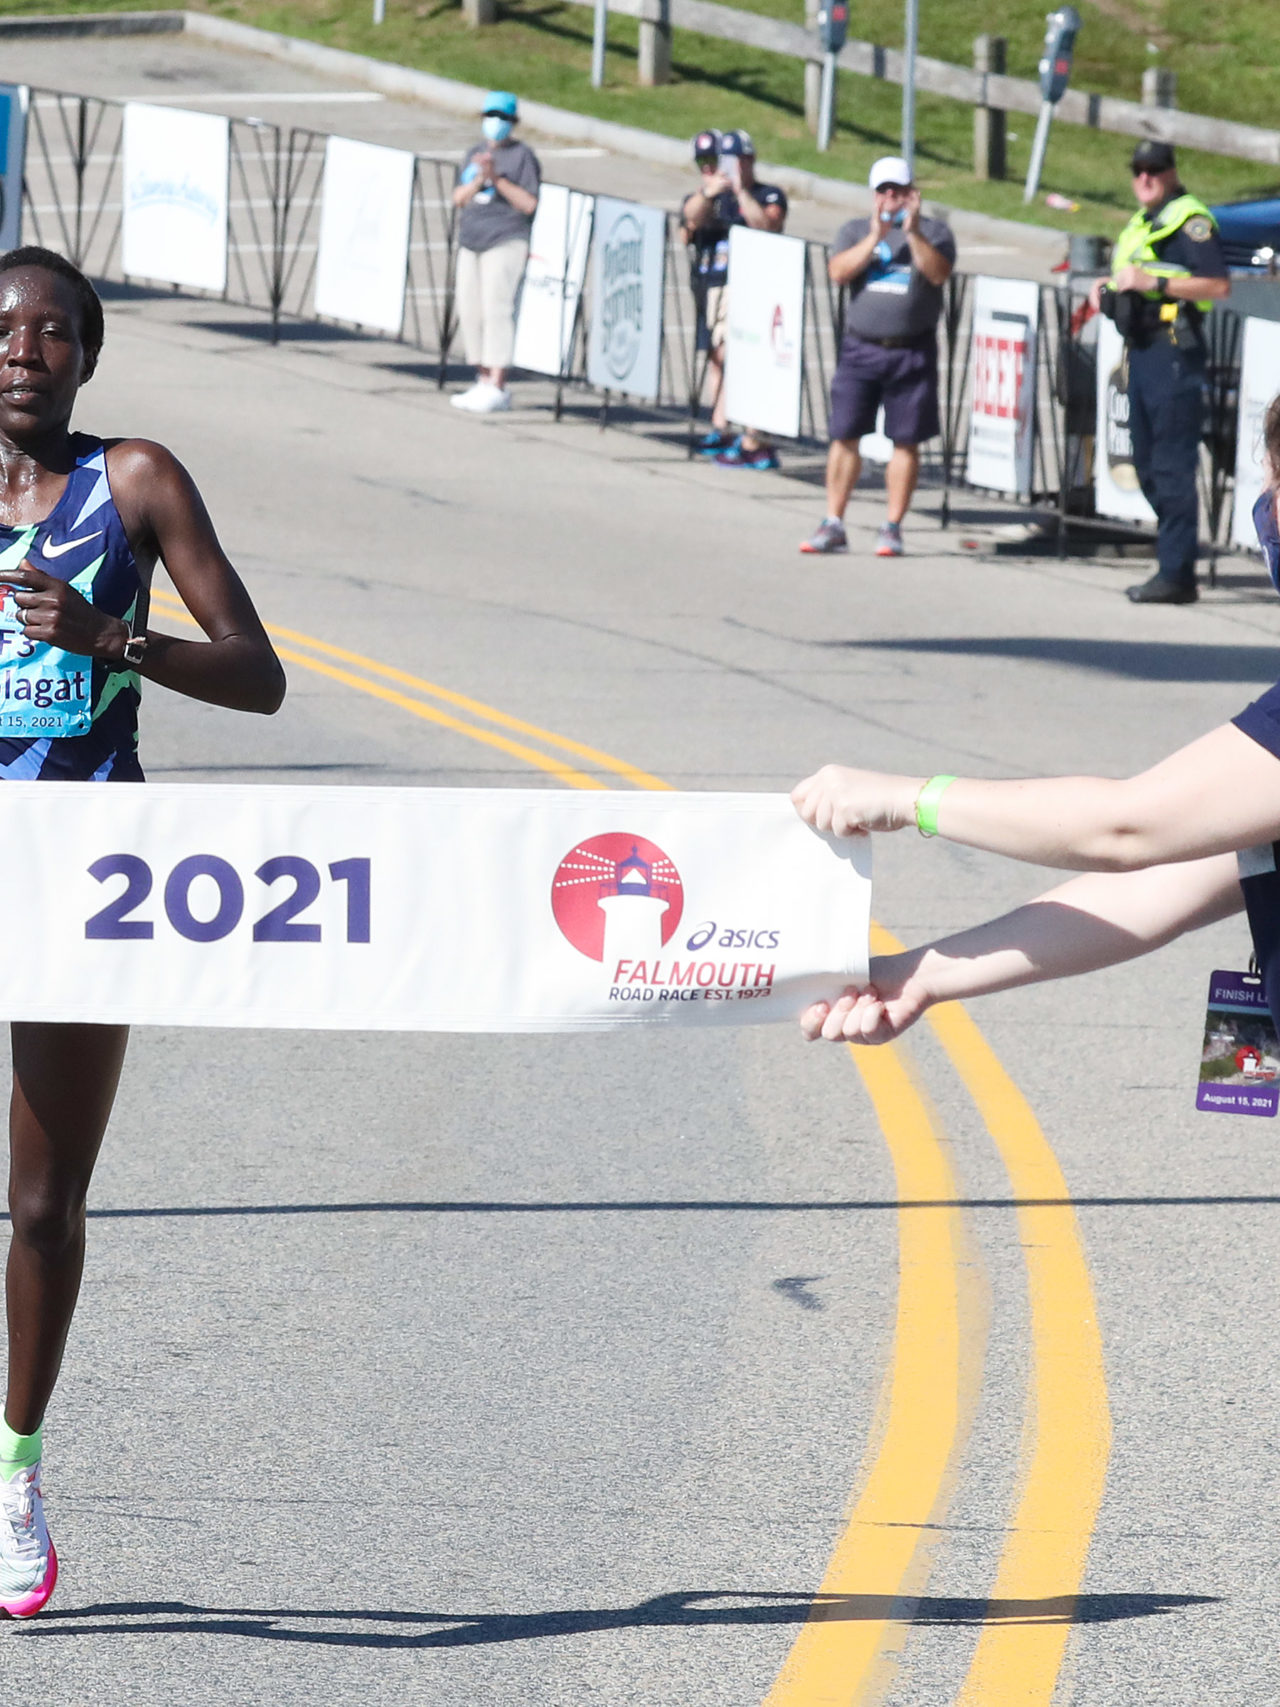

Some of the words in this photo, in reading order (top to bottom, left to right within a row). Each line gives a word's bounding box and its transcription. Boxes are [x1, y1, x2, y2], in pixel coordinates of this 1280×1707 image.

[8, 715, 28, 730] 15,
[31, 716, 63, 728] 2021
[85, 853, 370, 943] 2021
[718, 929, 781, 949] asics
[613, 959, 776, 987] FALMOUTH
[609, 987, 654, 1001] ROAD
[658, 988, 700, 1001] RACE
[703, 988, 733, 1000] EST.
[737, 988, 771, 1000] 1973
[1215, 988, 1255, 1002] FINISH
[1203, 1092, 1236, 1105] August
[1237, 1096, 1250, 1106] 15,
[1252, 1097, 1273, 1108] 2021
